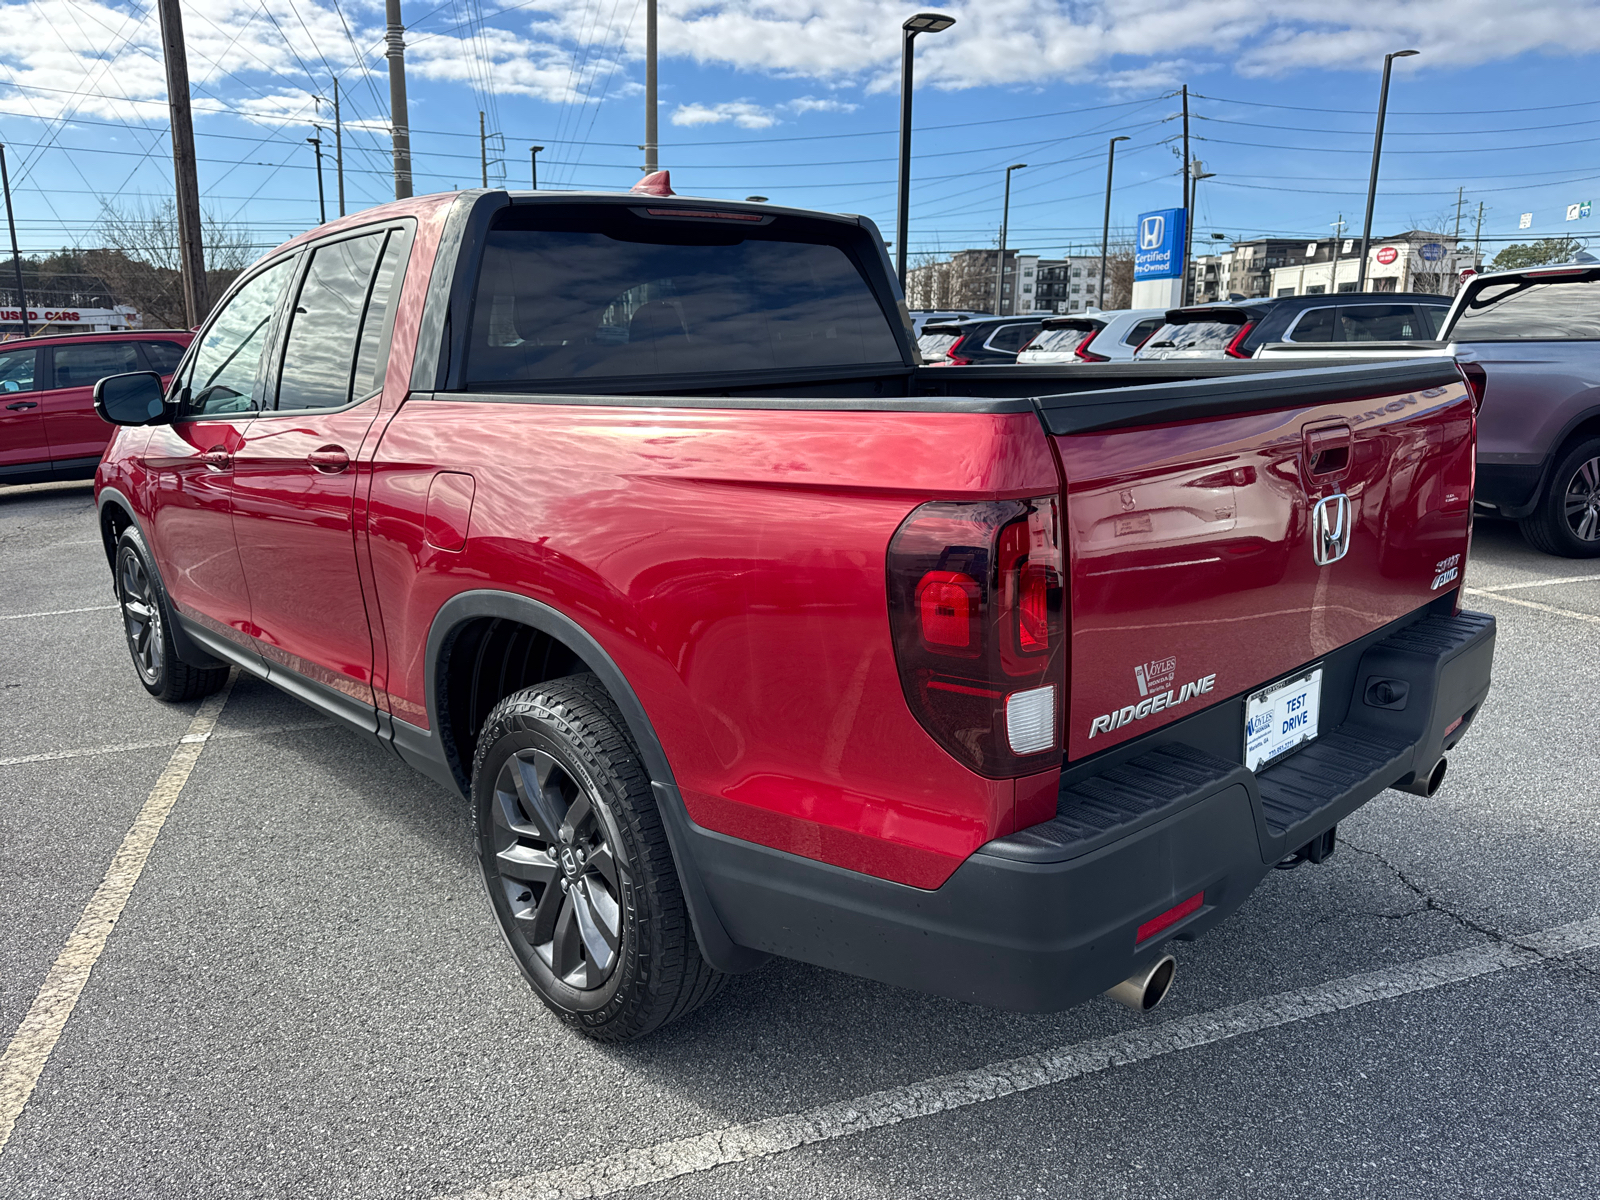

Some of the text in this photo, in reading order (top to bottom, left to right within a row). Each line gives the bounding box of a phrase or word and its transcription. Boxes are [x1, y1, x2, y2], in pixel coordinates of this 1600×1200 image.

[1135, 250, 1171, 263] Certified
[1134, 262, 1170, 273] Pre-Owned
[44, 312, 80, 321] CARS
[1143, 658, 1176, 682] VOYLES
[1147, 676, 1169, 688] HONDA
[1088, 673, 1217, 740] RIDGELINE
[1286, 693, 1307, 714] TEST
[1282, 710, 1308, 735] DRIVE
